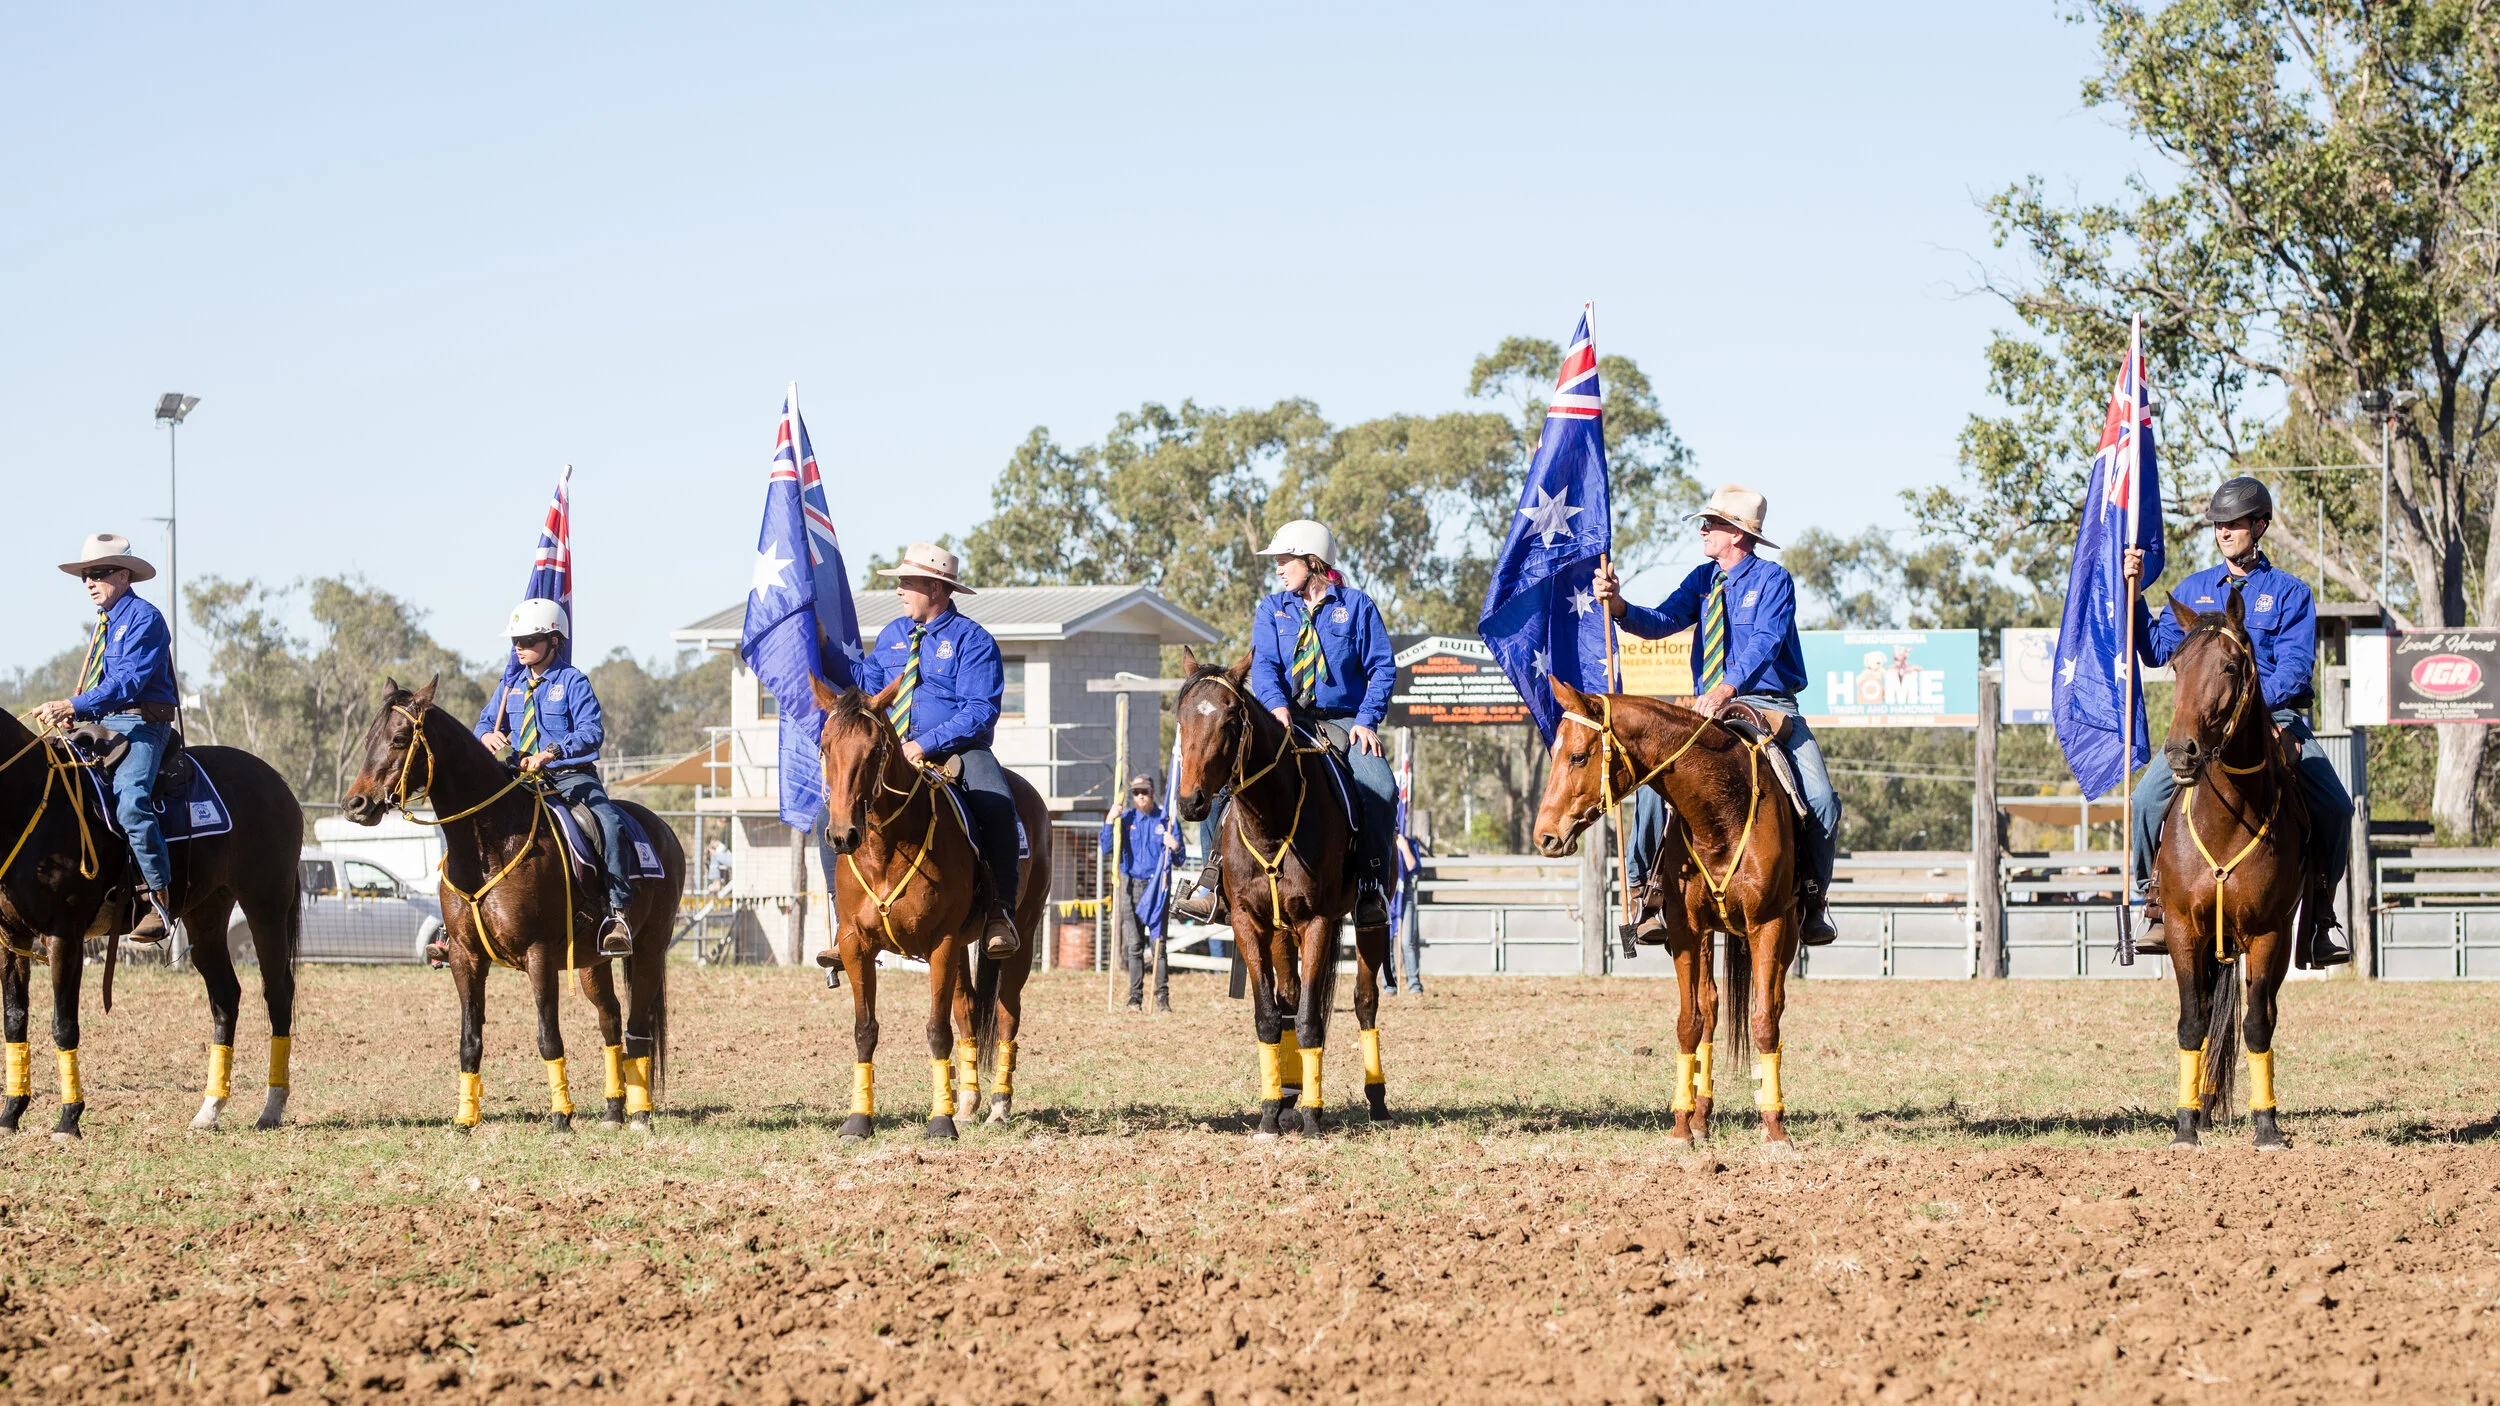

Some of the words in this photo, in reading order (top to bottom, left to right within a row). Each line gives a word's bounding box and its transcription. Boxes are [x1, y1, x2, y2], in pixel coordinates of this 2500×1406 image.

[1397, 644, 1429, 661] BLOK
[1439, 640, 1486, 655] BUILT
[2396, 633, 2445, 654] Local
[2445, 632, 2497, 653] Heroes
[2420, 662, 2473, 686] IGA
[1826, 669, 1946, 705] HOME
[1408, 704, 1447, 715] Mitch
[1866, 704, 1888, 715] AND
[2032, 710, 2050, 722] 07
